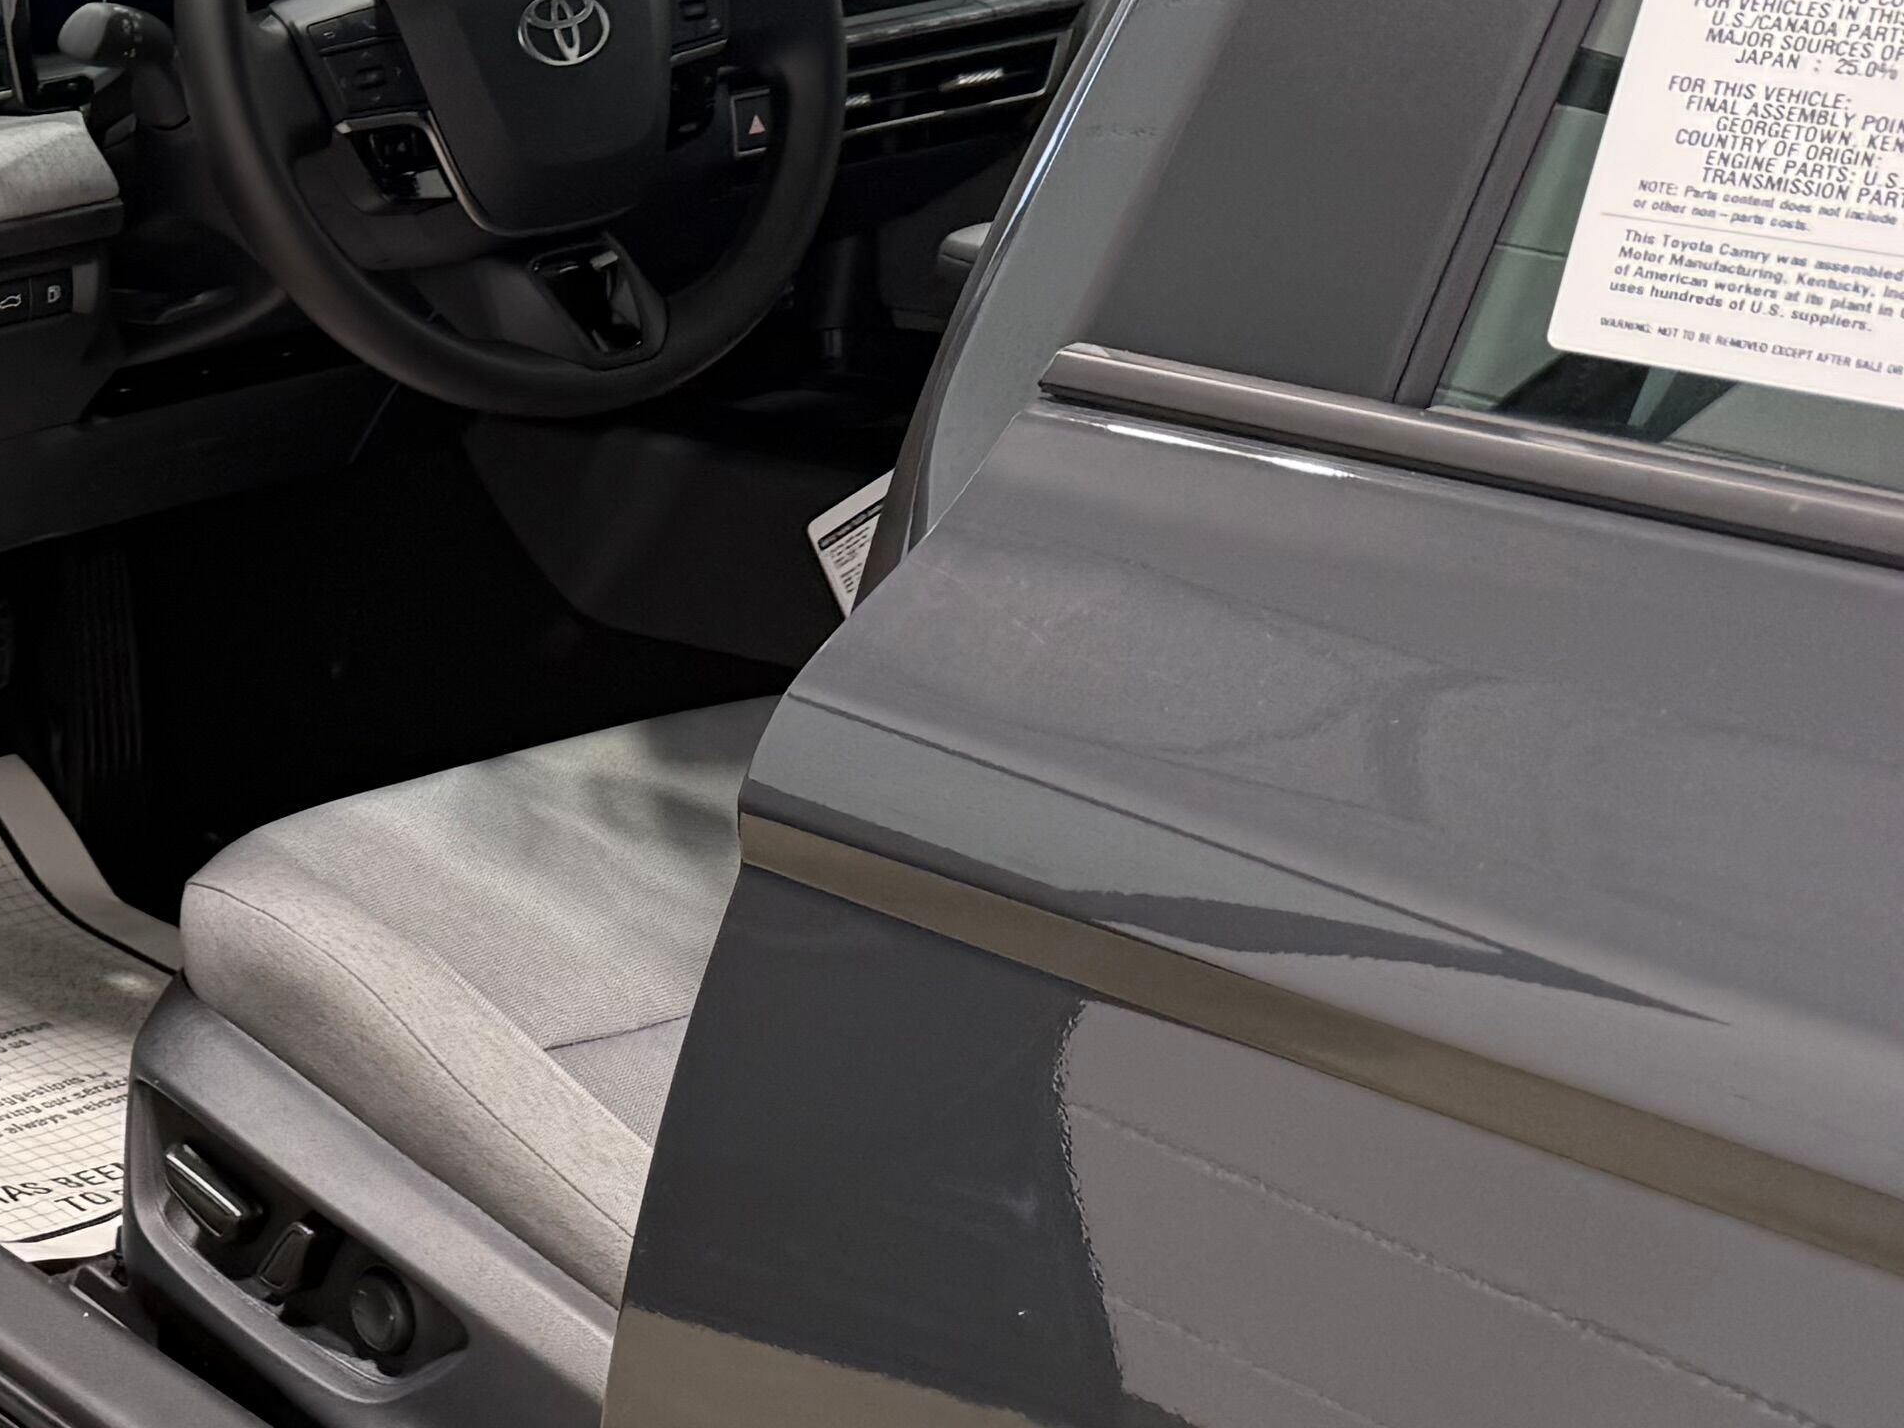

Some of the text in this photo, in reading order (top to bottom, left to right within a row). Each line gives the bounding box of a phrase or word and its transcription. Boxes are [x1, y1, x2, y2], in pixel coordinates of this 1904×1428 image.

[1712, 11, 1904, 46] U.S./CANADA PART
[1839, 5, 1859, 20] IN
[1705, 28, 1774, 49] MAJOR
[1781, 35, 1874, 59] SOURCES
[1735, 49, 1801, 69] JAPAN
[1834, 58, 1898, 80] 25.0%
[1668, 75, 1852, 110] FOR THIS VEHICLE:
[1686, 95, 1739, 115] FINAL
[1746, 102, 1856, 128] ASSEMBLY
[1675, 128, 1883, 167] COUNTRY OF ORIGIN:
[1702, 167, 1850, 201] TRANSMISSION
[1705, 150, 1779, 173] ENGINE
[1783, 160, 1856, 184] PARTS:
[1633, 198, 1647, 209] or
[1651, 200, 1686, 214] other
[1638, 179, 1897, 225] NOTE: Parts content does not include
[1618, 245, 1664, 264] Motor
[1625, 229, 1904, 282] This Toyota Camry was assembled
[1609, 281, 1872, 332] uses hundreds of U.S. suppliers.
[1614, 264, 1630, 276] of
[1633, 266, 1708, 288] American
[1715, 281, 1778, 299] workers
[1784, 291, 1800, 302] at
[1805, 293, 1823, 306] its
[1830, 298, 1872, 313] plant
[1878, 304, 1894, 317] in
[1683, 329, 1696, 341] TO
[1698, 332, 1711, 344] BE
[1771, 344, 1813, 361] EXCEPT
[1816, 352, 1851, 367] AFTER
[40, 1096, 75, 1110] our
[72, 1077, 128, 1100] servic
[3, 1112, 68, 1136] always
[54, 1191, 114, 1212] TO
